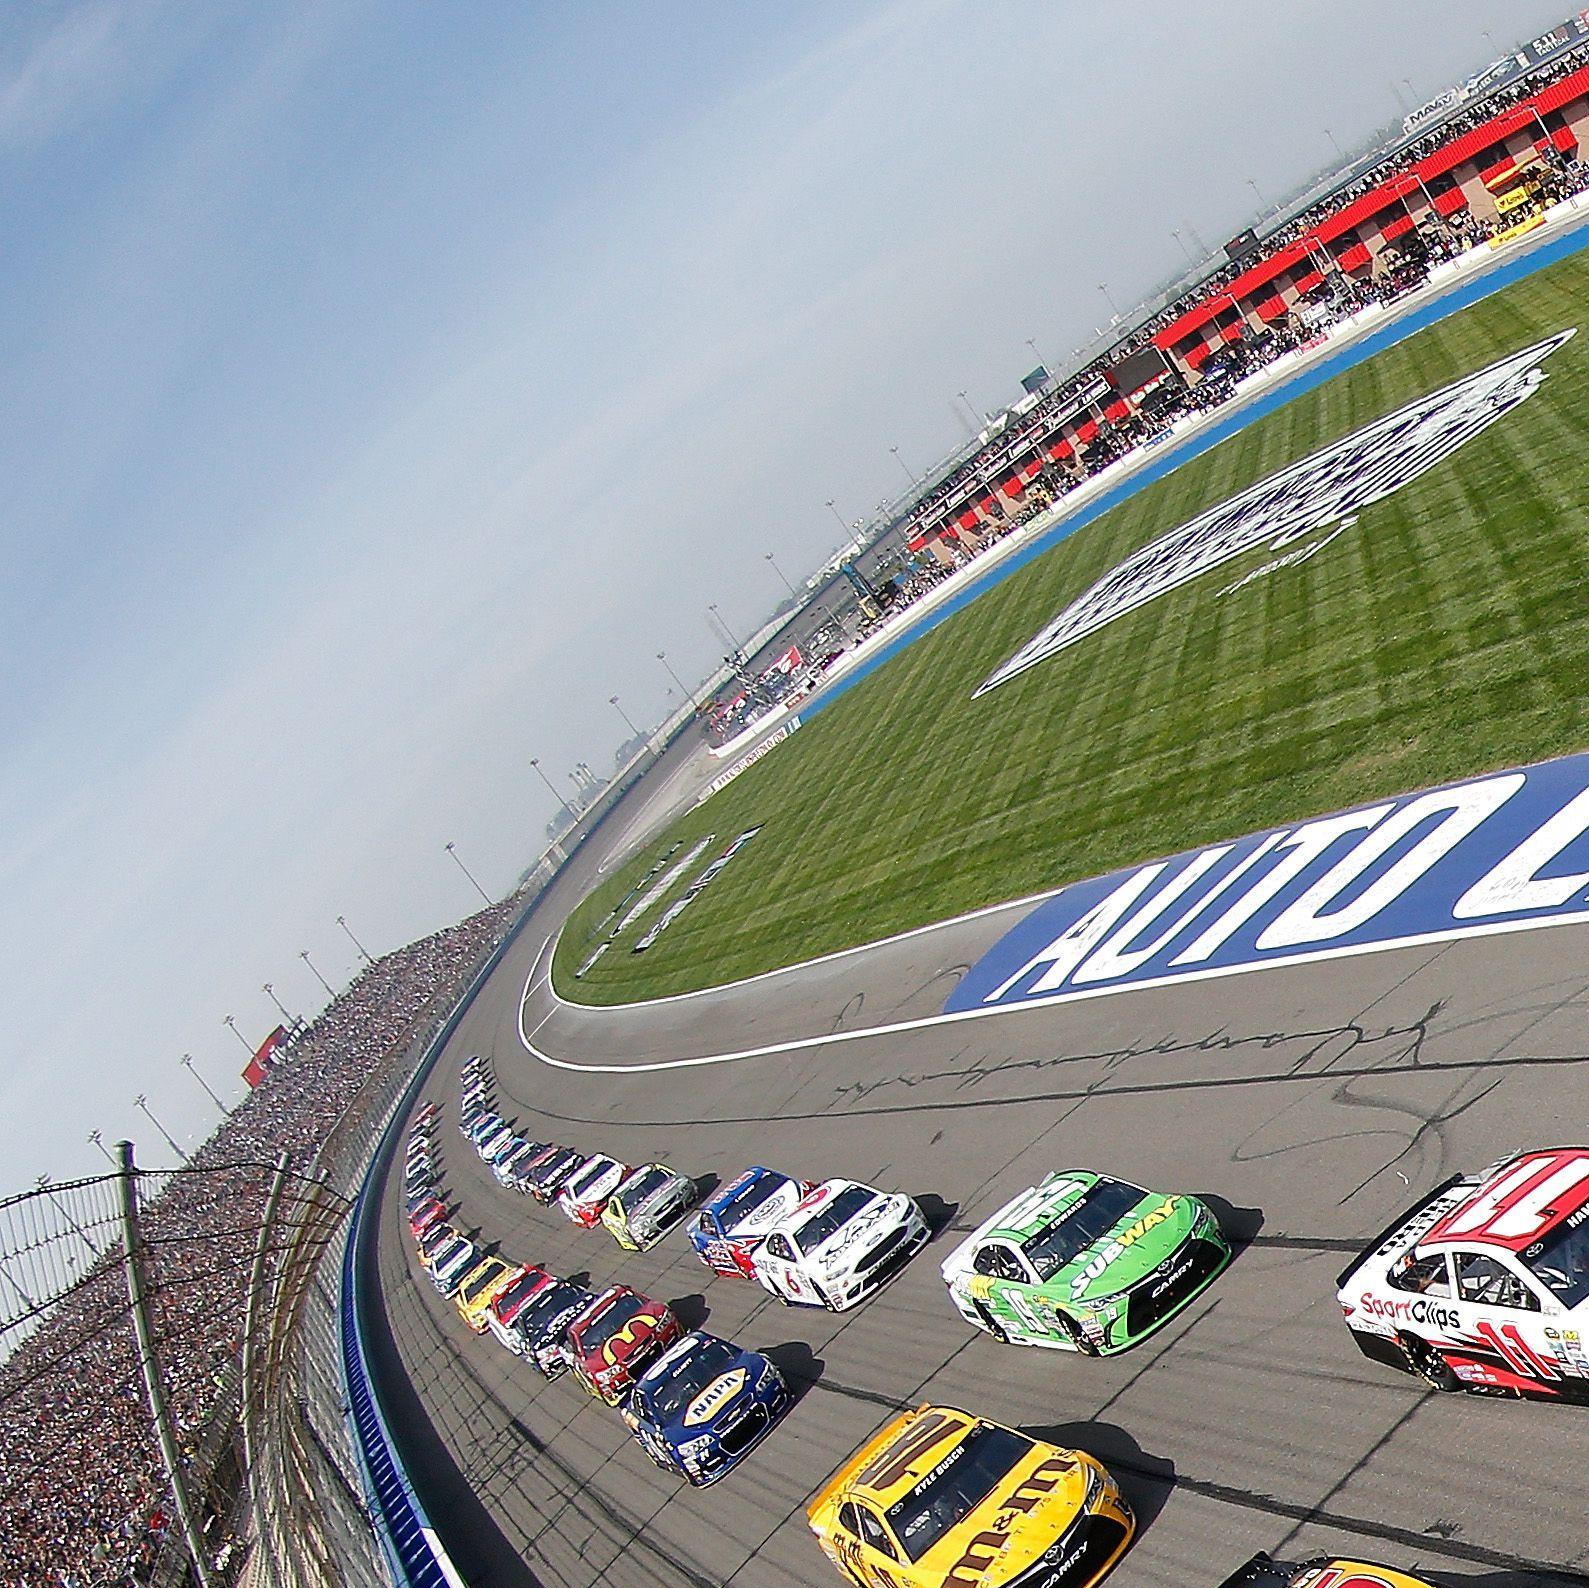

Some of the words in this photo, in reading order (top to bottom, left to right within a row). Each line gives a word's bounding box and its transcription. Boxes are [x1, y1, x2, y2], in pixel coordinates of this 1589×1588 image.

[983, 770, 1528, 1003] AUTO
[1070, 1193, 1181, 1299] SUBWAY
[1151, 1258, 1194, 1299] CAMRY
[1473, 1318, 1562, 1382] 11
[694, 1373, 741, 1419] NAPA
[913, 1468, 938, 1497] KYLE
[936, 1446, 966, 1478] BUSCH
